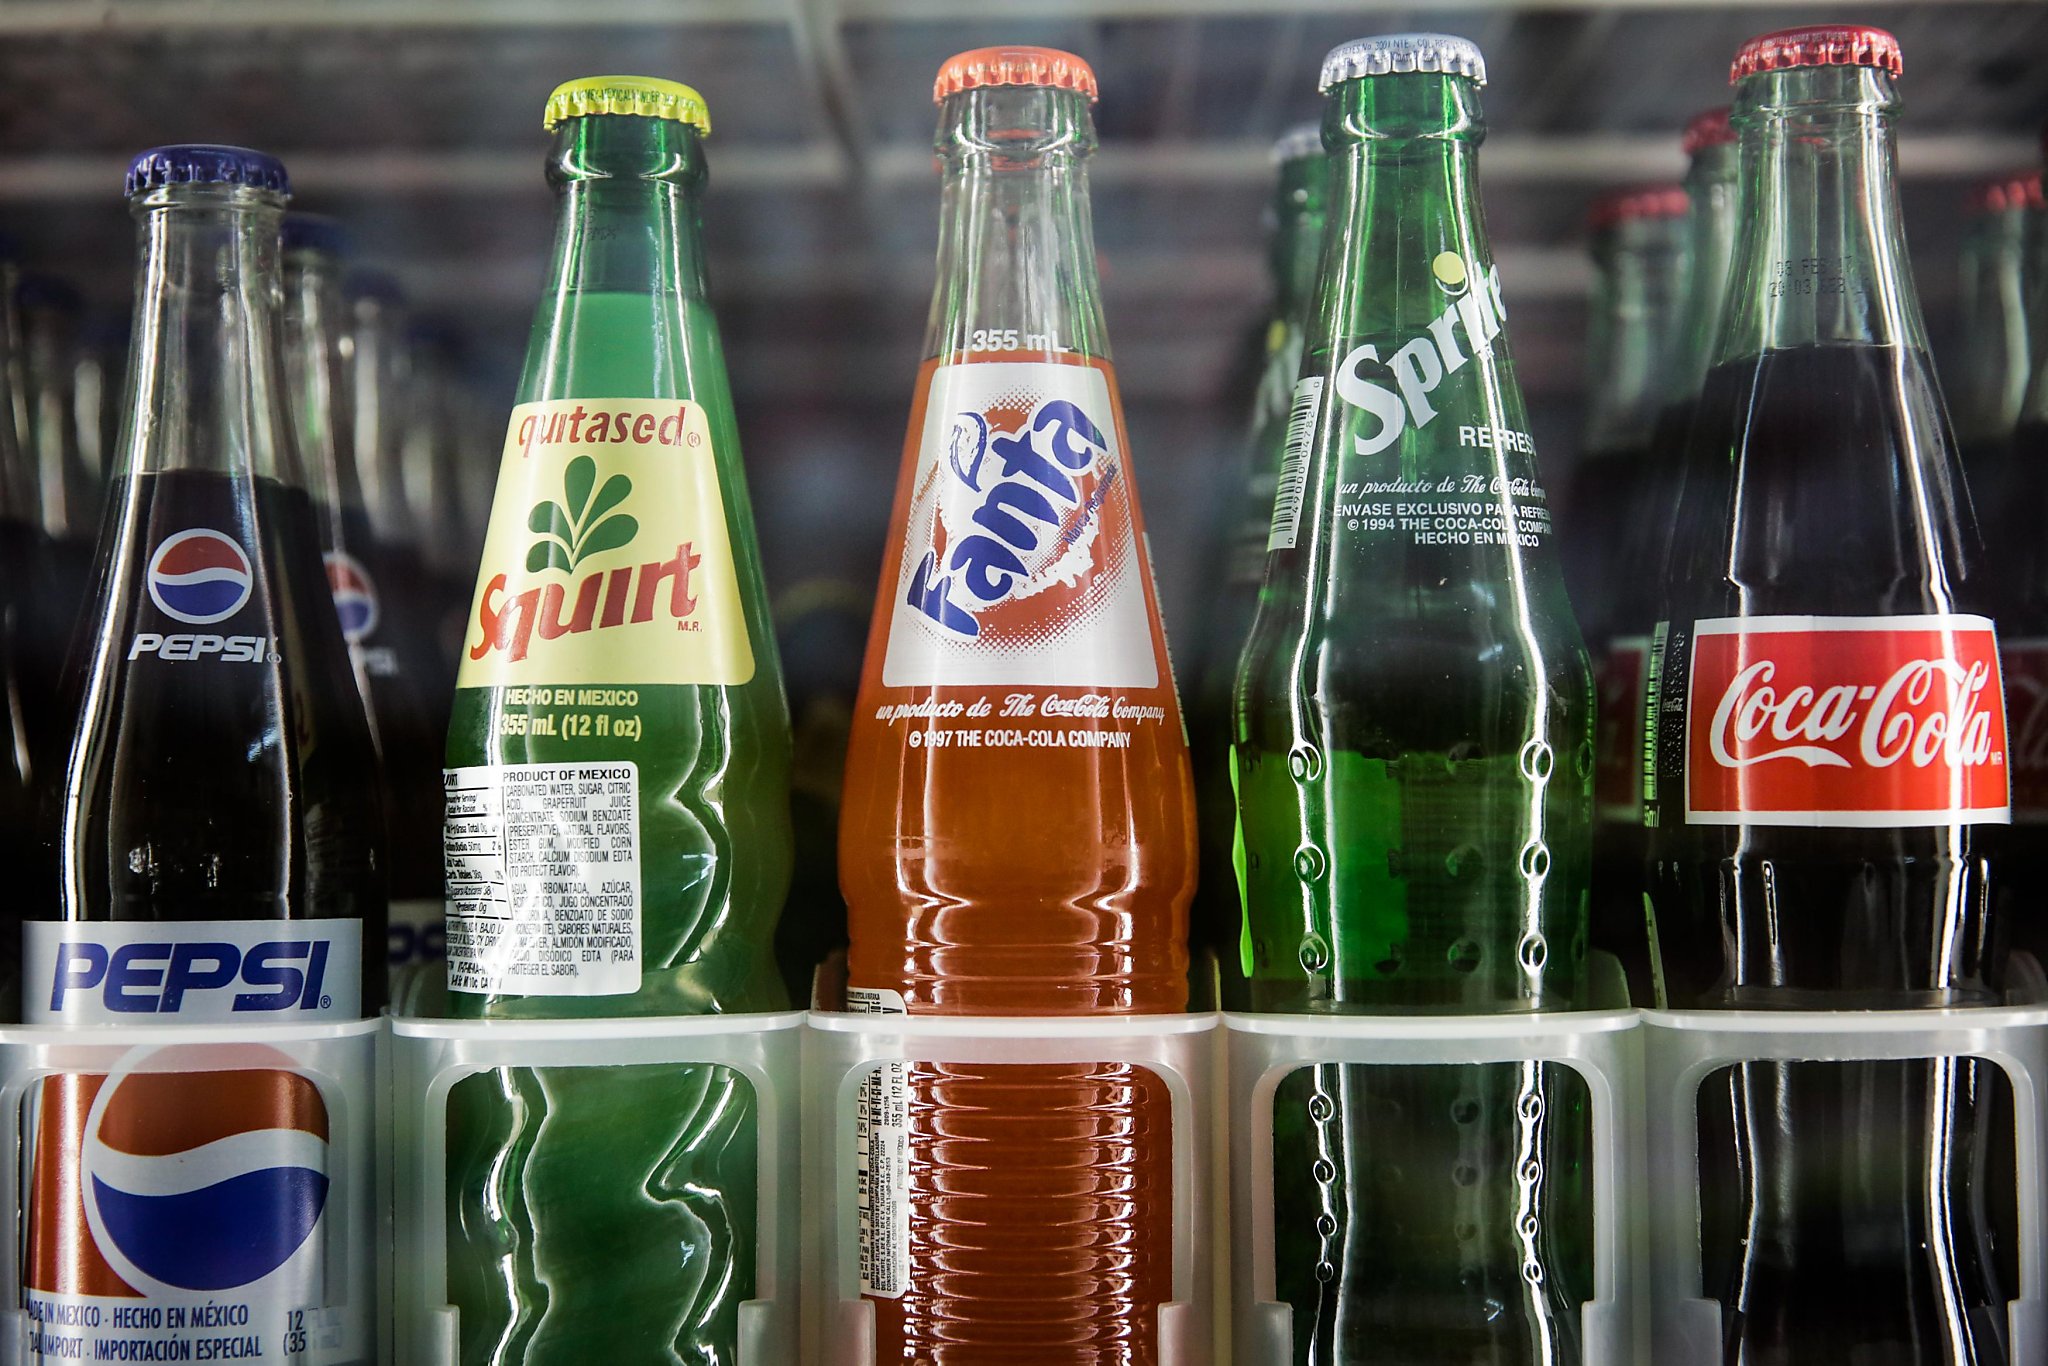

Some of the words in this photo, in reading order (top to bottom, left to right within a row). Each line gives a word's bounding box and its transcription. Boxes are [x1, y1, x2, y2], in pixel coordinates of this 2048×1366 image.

[971, 329, 1019, 352] 355
[1026, 330, 1069, 353] mL
[1336, 253, 1507, 456] Sprite
[518, 405, 687, 458] quitased
[1292, 466, 1306, 514] 49000
[1358, 477, 1433, 500] producto
[1437, 476, 1455, 493] de
[1460, 474, 1486, 494] The
[907, 400, 1108, 637] Fanta
[1333, 503, 1392, 518] ENVASE
[1397, 502, 1482, 516] EXCLUSIVO
[1486, 503, 1520, 518] PAA
[1362, 518, 1396, 531] 1994
[1400, 517, 1431, 531] THE
[1434, 518, 1517, 532] COCA-COL
[1415, 532, 1470, 545] HECHO
[1473, 532, 1494, 545] EN
[470, 541, 702, 663] Squirt
[127, 633, 267, 664] PEPSI
[505, 688, 553, 705] HECHO
[554, 689, 576, 706] EN
[578, 690, 639, 707] MEXICO
[875, 702, 894, 721] un
[888, 696, 965, 727] producto
[966, 696, 993, 719] de
[999, 692, 1036, 719] The
[1111, 693, 1165, 727] Company
[1709, 660, 1992, 768] Coca-Cola
[501, 713, 528, 736] 355
[531, 713, 558, 736] mL
[561, 714, 592, 741] (12
[595, 714, 610, 737] fl
[613, 715, 642, 742] oz)
[955, 729, 982, 748] THE
[984, 729, 1068, 748] COCA-COLA
[1068, 729, 1131, 749] COMPANY
[504, 770, 556, 782] PRODUCT
[559, 769, 576, 781] OF
[579, 768, 631, 781] MEXICO
[506, 784, 547, 797] CARBONATED
[550, 783, 576, 797] WATER,
[578, 782, 605, 796] SUGAR,
[607, 781, 631, 795] CITRIC
[543, 797, 588, 810] GRAPEFRUIT
[609, 795, 632, 808] JUICE
[560, 810, 588, 823] SODIUM
[592, 809, 632, 822] BENZOATE
[564, 823, 594, 836] ATURAL
[596, 822, 632, 837] FLAVORS,
[610, 836, 632, 849] CORN
[612, 849, 633, 862] EDTA
[558, 895, 578, 908] JUGO
[580, 894, 634, 908] CONCENTRADO
[554, 909, 594, 922] BENZOATO
[597, 909, 608, 921] DE
[610, 908, 634, 921] SODIO
[557, 922, 590, 936] SABORES
[581, 949, 602, 962] EDTA
[50, 940, 331, 1013] PEPSI
[891, 1112, 902, 1128] 355
[45, 1302, 54, 1324] IN
[56, 1303, 100, 1328] MEXICO
[113, 1307, 161, 1329] HECHO
[167, 1306, 186, 1329] EN
[190, 1300, 249, 1329] MÉXICO
[287, 1310, 304, 1332] 12
[44, 1334, 83, 1359] IMPORT
[94, 1333, 189, 1362] IMPORTACIÓN
[195, 1335, 263, 1361] ESPECIAL
